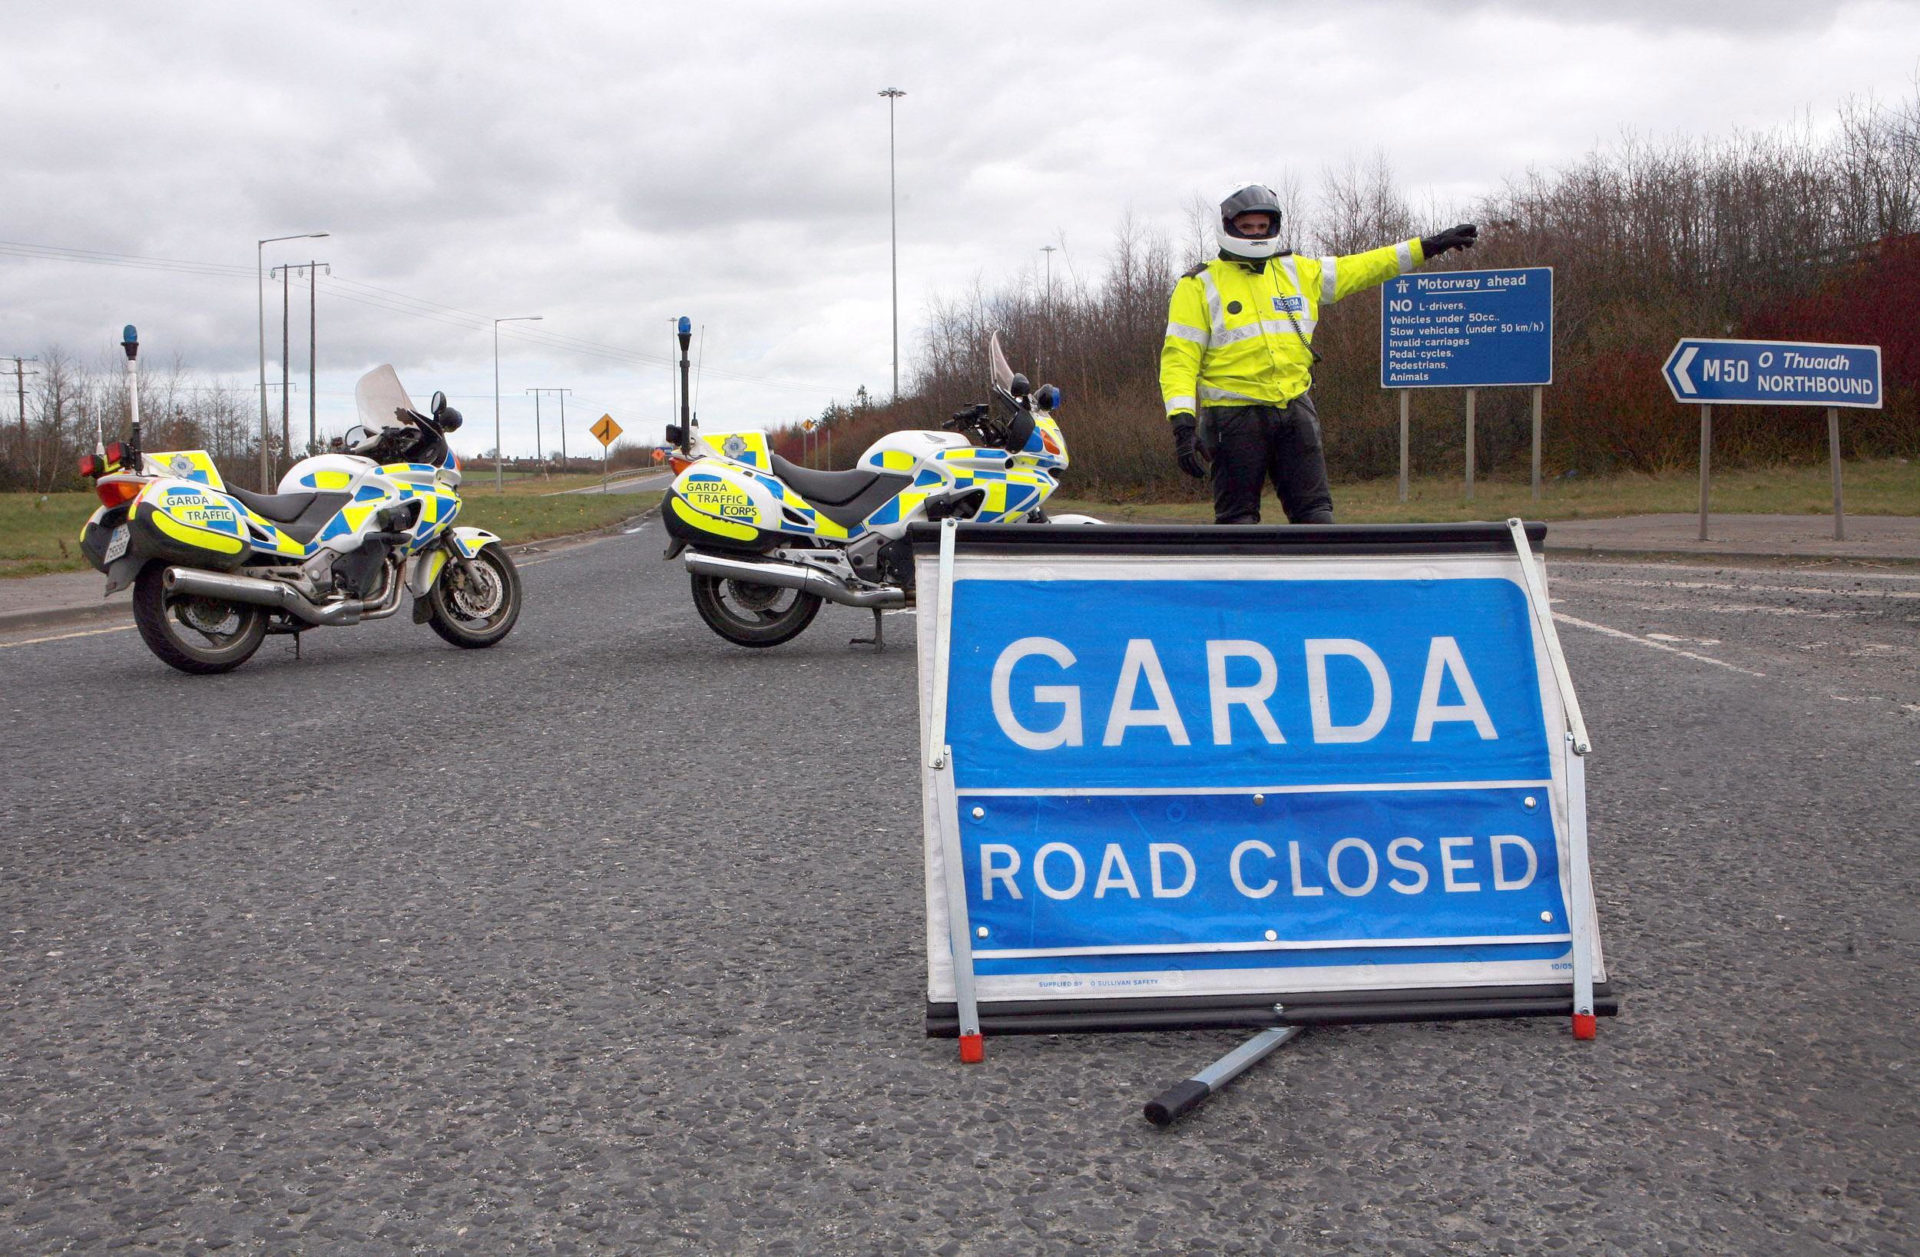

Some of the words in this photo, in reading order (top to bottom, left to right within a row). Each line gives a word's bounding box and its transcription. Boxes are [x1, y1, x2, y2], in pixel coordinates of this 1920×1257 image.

[1418, 278, 1480, 290] Motorway
[1487, 274, 1526, 287] ahead
[1390, 299, 1412, 312] NO
[1390, 315, 1431, 324] Vehicles
[1436, 314, 1463, 322] under
[1390, 327, 1414, 336] Slow
[1419, 326, 1459, 335] vehicles
[1465, 324, 1496, 335] (under
[1501, 325, 1513, 333] 50
[1515, 321, 1544, 333] km/h)
[1390, 361, 1448, 370] Pedestrians.
[1758, 351, 1773, 368] O
[1390, 372, 1429, 381] Animals
[1703, 359, 1749, 383] M50
[1757, 375, 1873, 395] NORTHBOUND
[686, 483, 728, 493] GARDA
[166, 495, 210, 506] GARDA
[697, 494, 743, 504] TRAFFIC
[186, 510, 233, 521] TRAFFIC
[723, 506, 757, 516] CORPS
[990, 635, 1499, 751] GARDA
[980, 842, 1197, 901] ROAD
[1229, 835, 1539, 899] CLOSED
